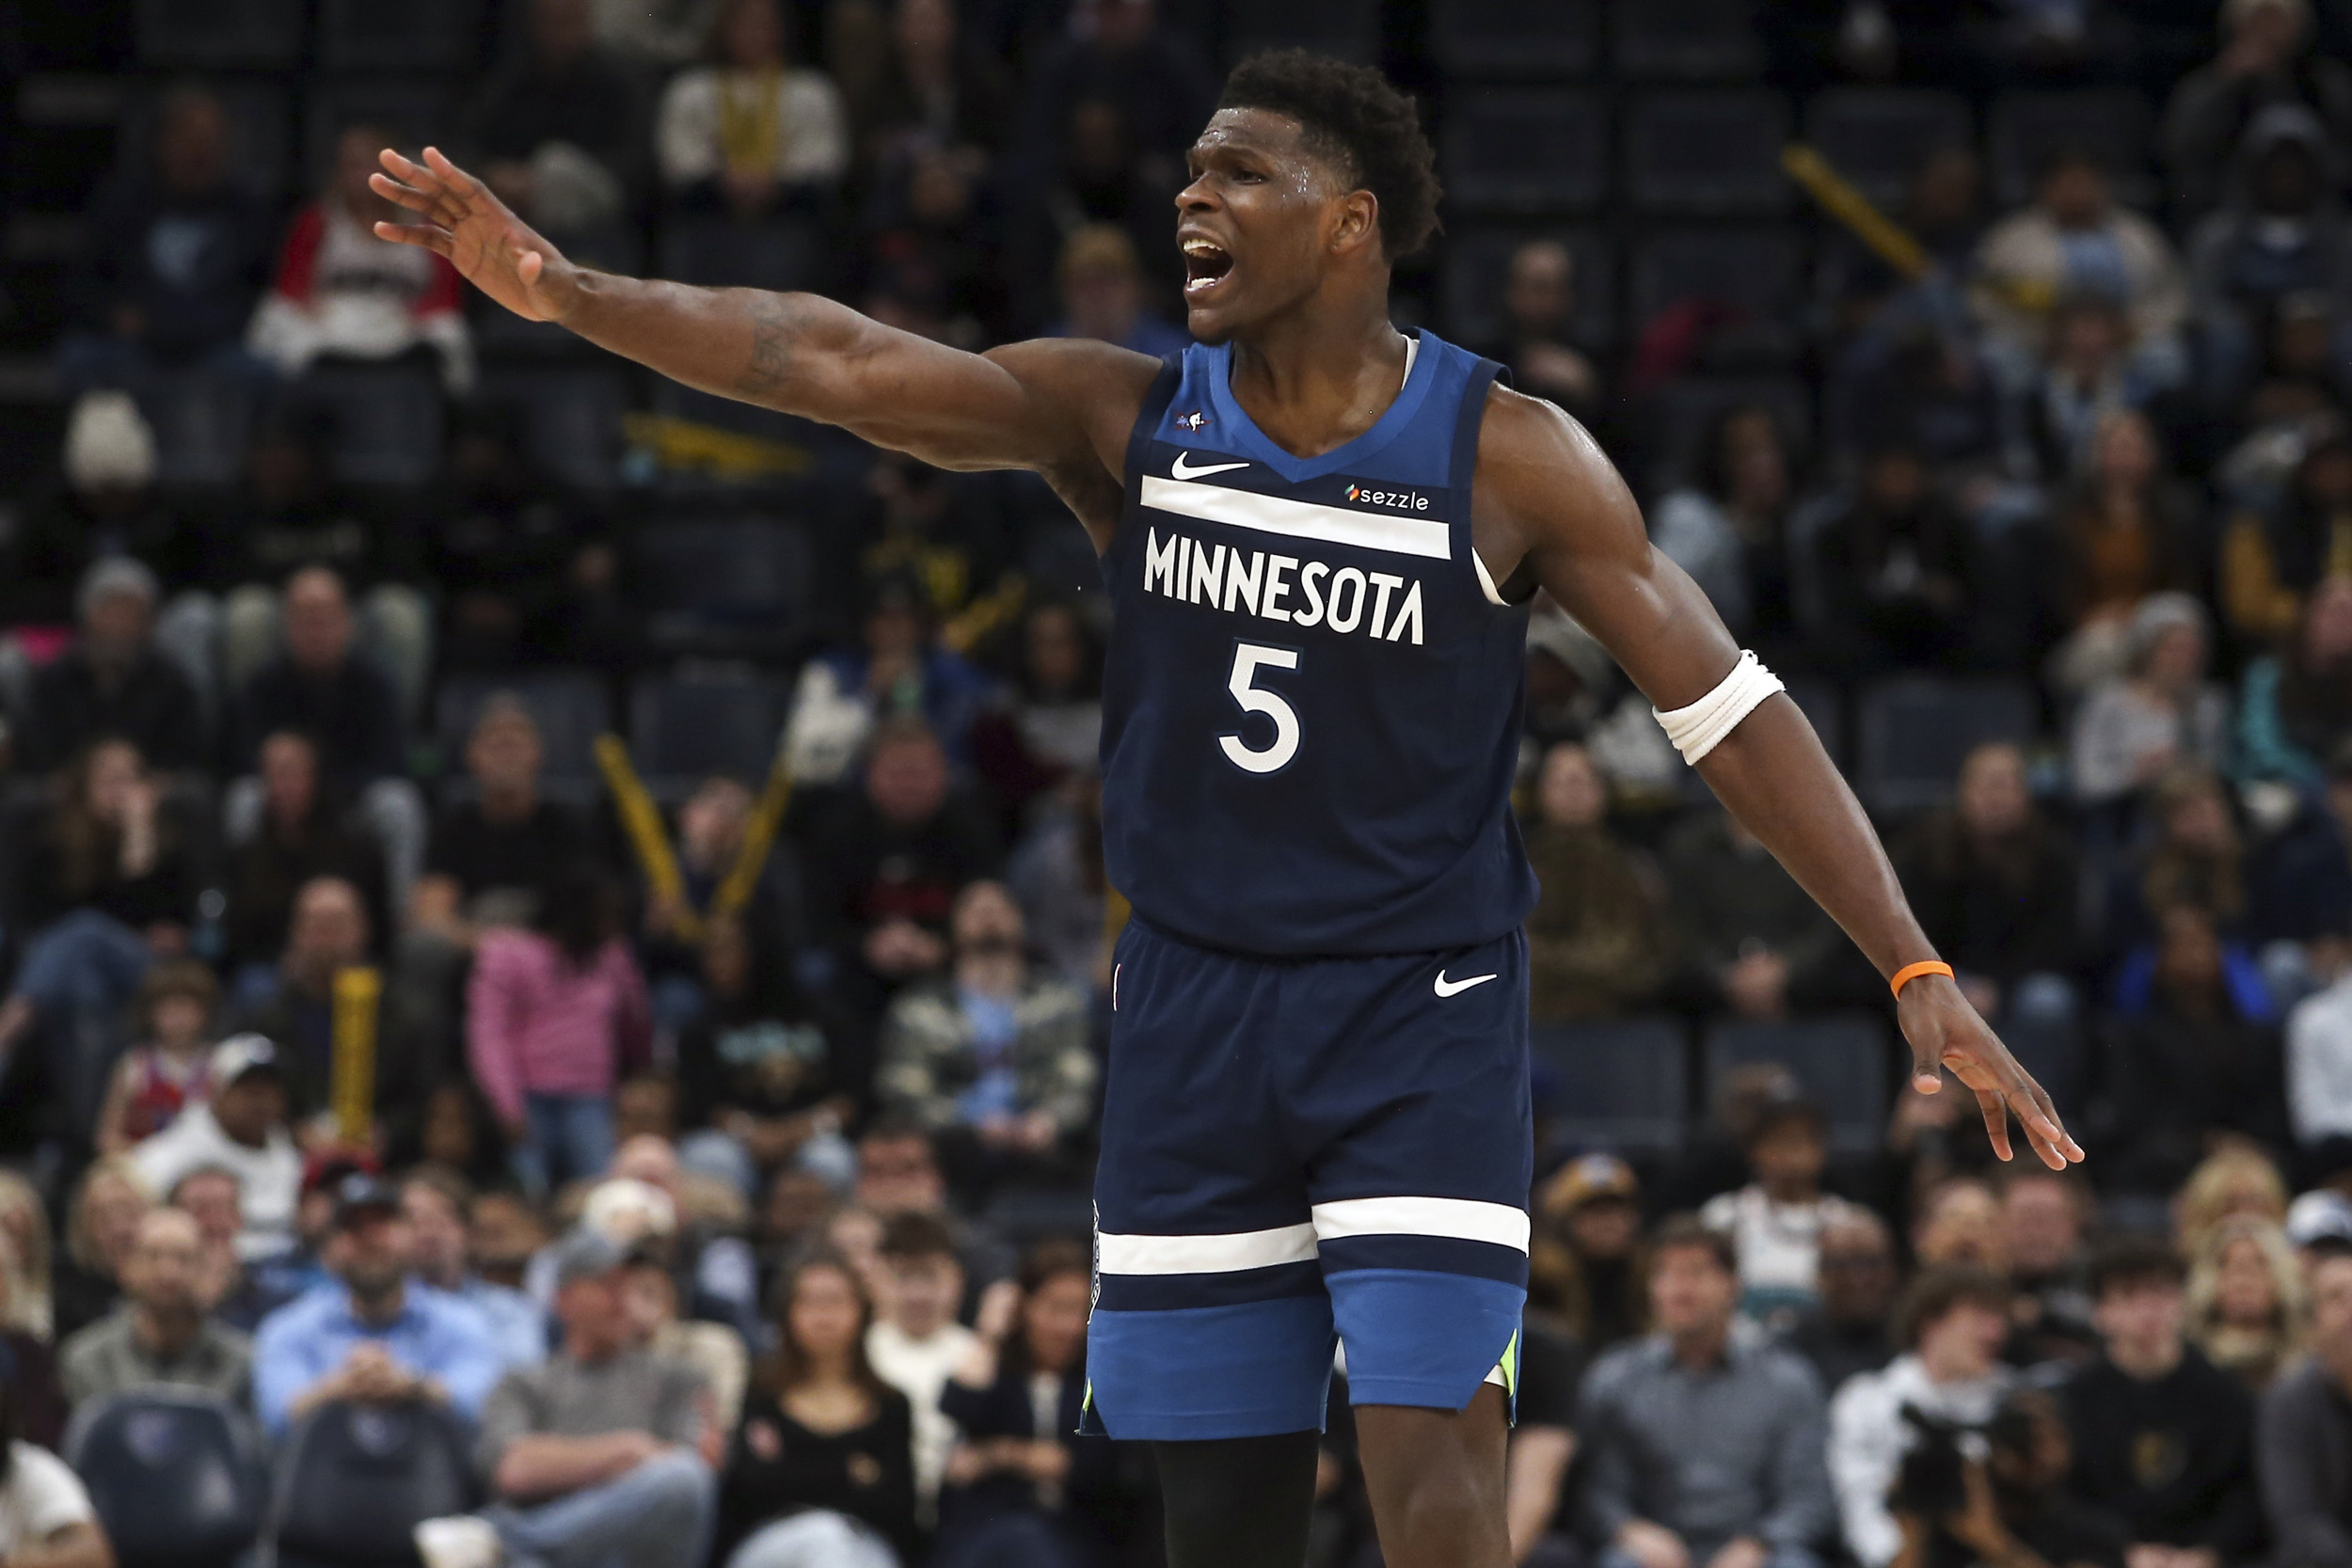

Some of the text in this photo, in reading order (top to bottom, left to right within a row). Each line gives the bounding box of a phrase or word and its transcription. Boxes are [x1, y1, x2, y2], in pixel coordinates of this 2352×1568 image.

[1360, 489, 1429, 511] sezzle
[1143, 526, 1423, 645] MINNESOTA
[1218, 642, 1300, 773] 5
